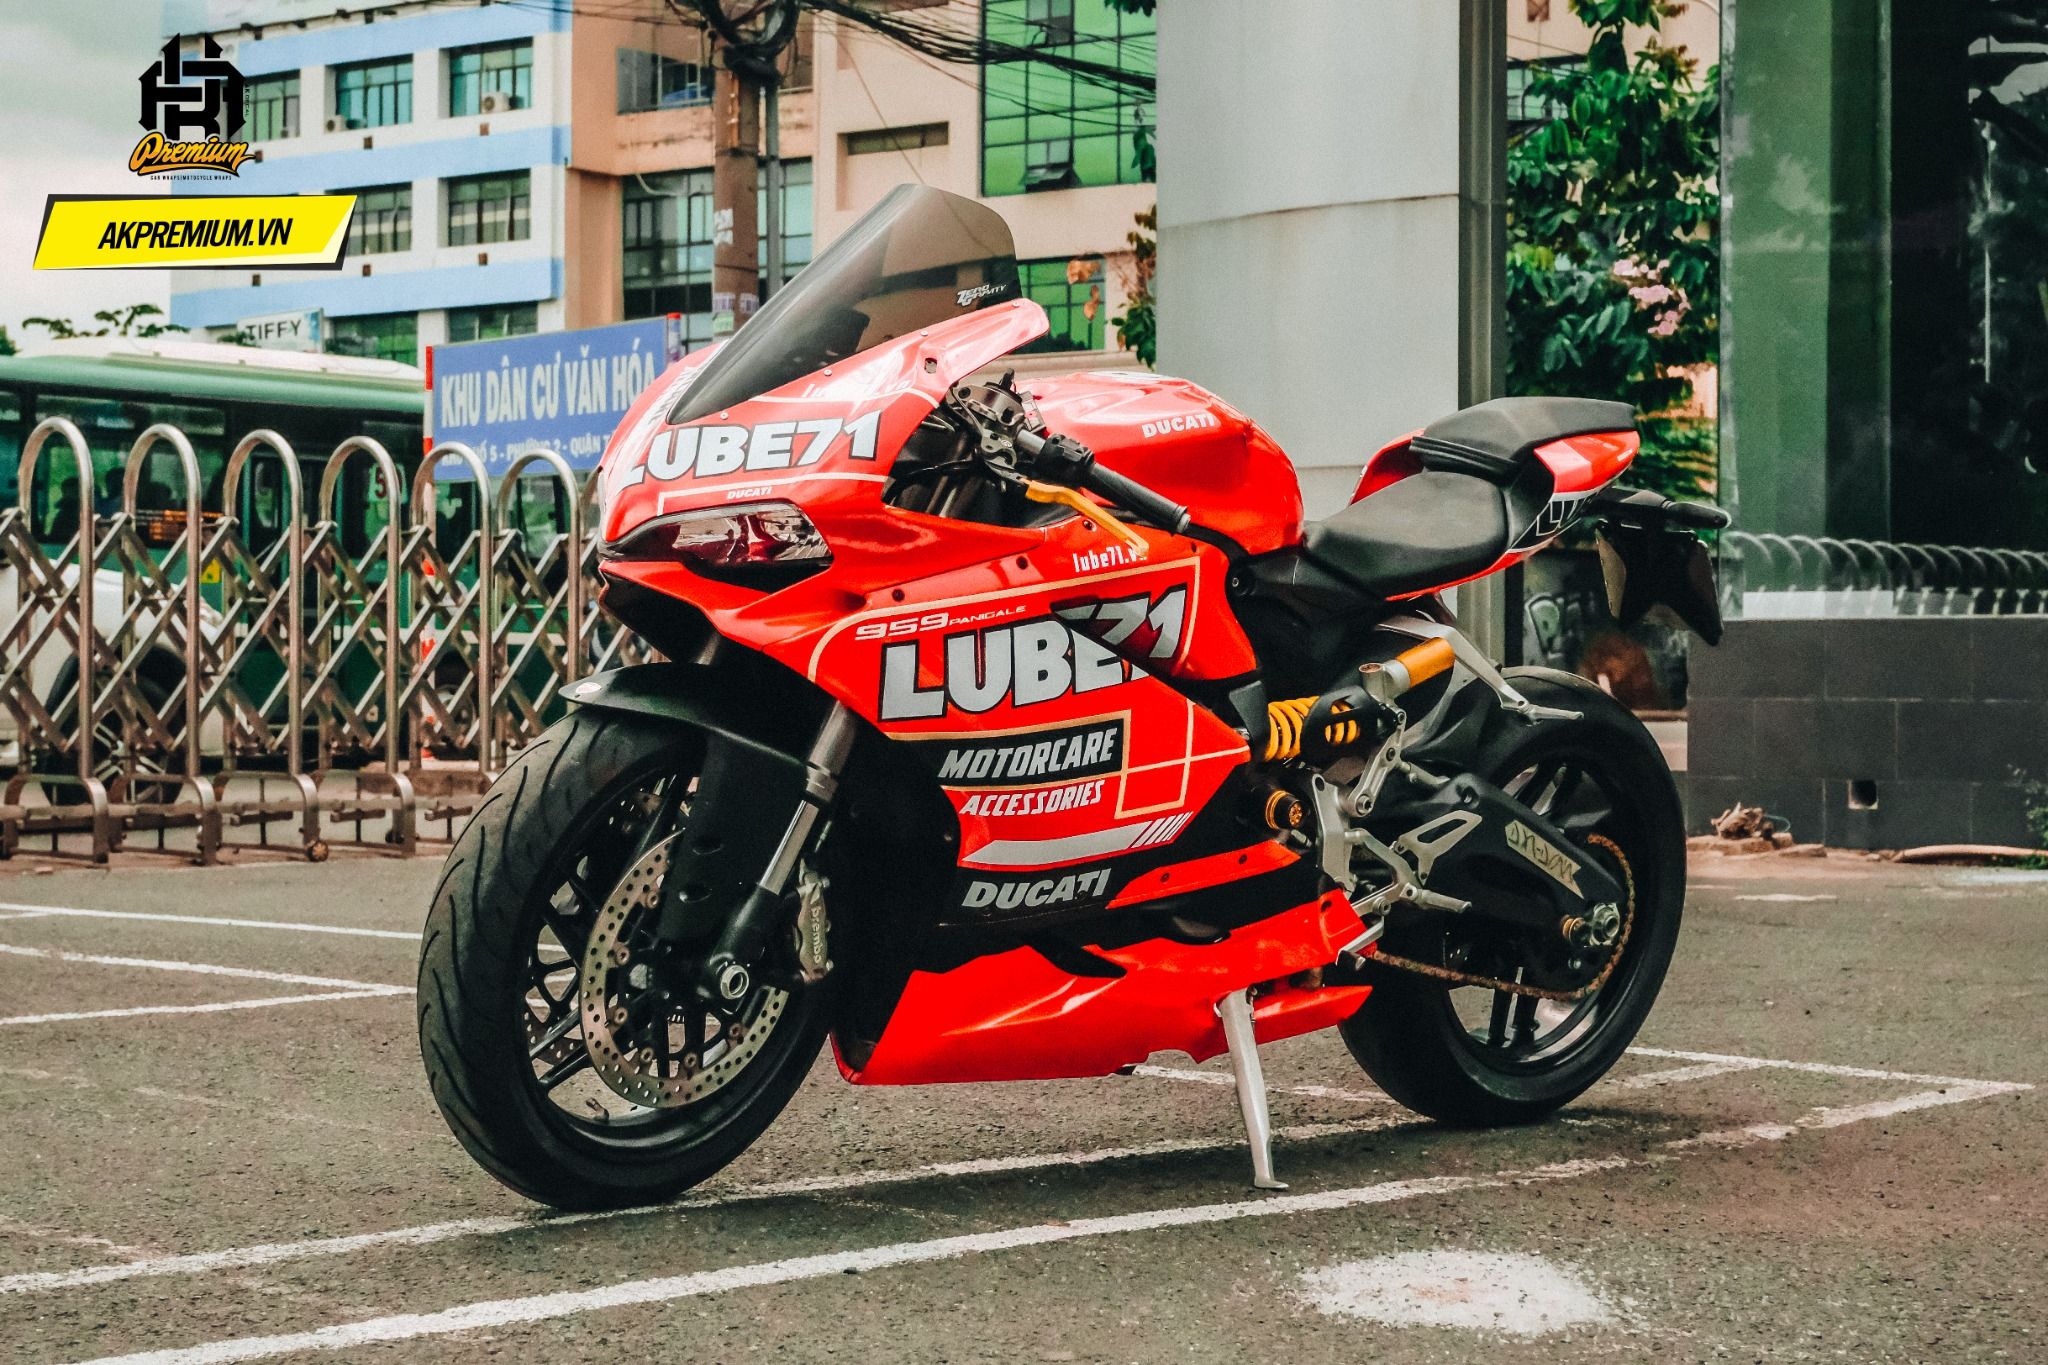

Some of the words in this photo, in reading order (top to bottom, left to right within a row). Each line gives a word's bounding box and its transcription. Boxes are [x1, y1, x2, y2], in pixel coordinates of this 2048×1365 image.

[441, 371, 481, 428] KHU
[486, 355, 527, 424] DÂN
[531, 351, 561, 420] CƯ
[565, 345, 607, 416] VĂN
[1141, 414, 1215, 439] DUCATI
[616, 409, 882, 496] LUBE71
[727, 486, 772, 500] DUCATI
[1072, 545, 1147, 573] lube71.v
[855, 612, 949, 640] 959
[949, 605, 1027, 626] PANIGALE
[878, 582, 1188, 722] LUBE71
[937, 728, 1117, 779] MOTORCARE
[959, 779, 1105, 816] ACCESSORIES
[961, 867, 1112, 909] DUCATI
[811, 904, 823, 964] brembo
